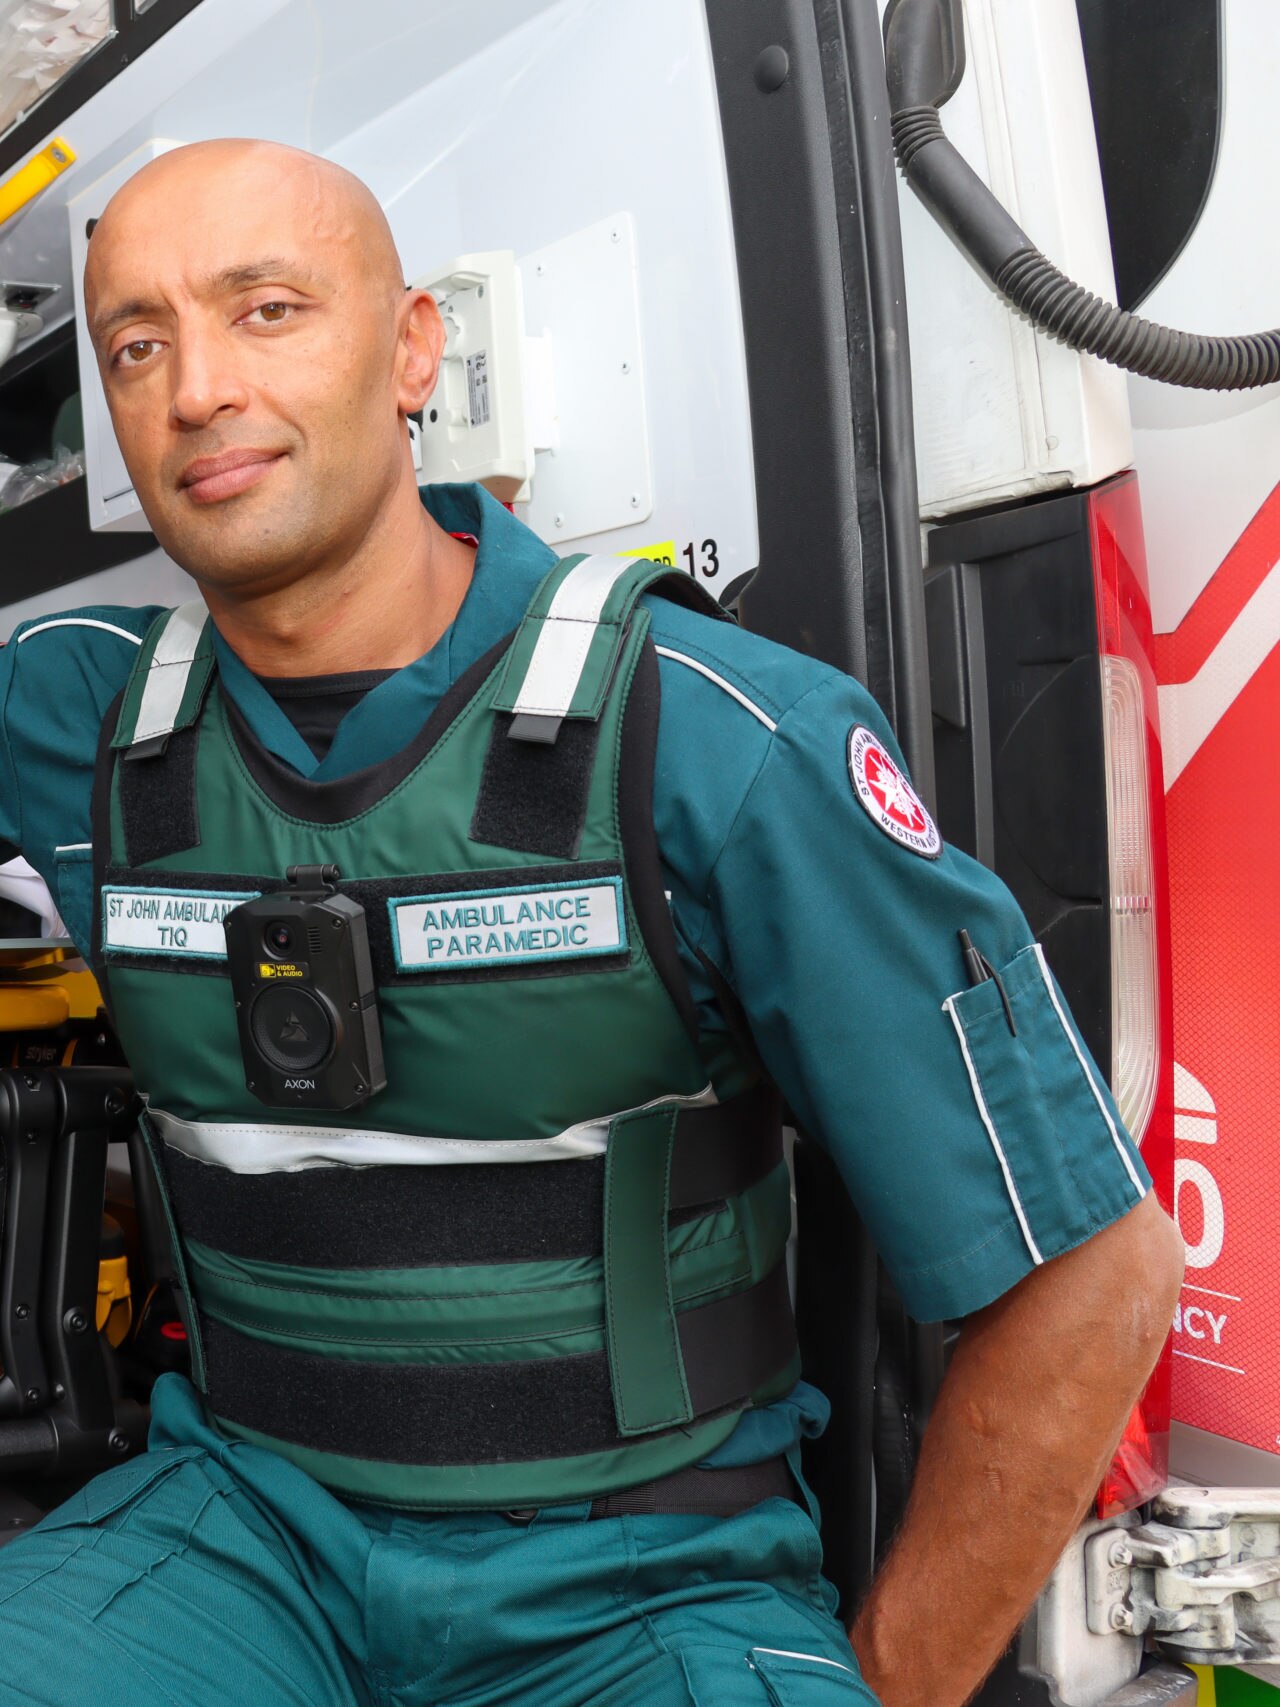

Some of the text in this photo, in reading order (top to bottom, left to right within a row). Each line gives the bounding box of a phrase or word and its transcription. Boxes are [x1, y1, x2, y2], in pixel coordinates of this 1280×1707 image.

[683, 539, 719, 578] 13
[109, 898, 239, 924] ST JOHN AMBULAN
[423, 896, 591, 932] AMBULANCE
[158, 925, 188, 947] TIQ
[427, 923, 588, 959] PARAMEDIC
[284, 1080, 315, 1089] AXON
